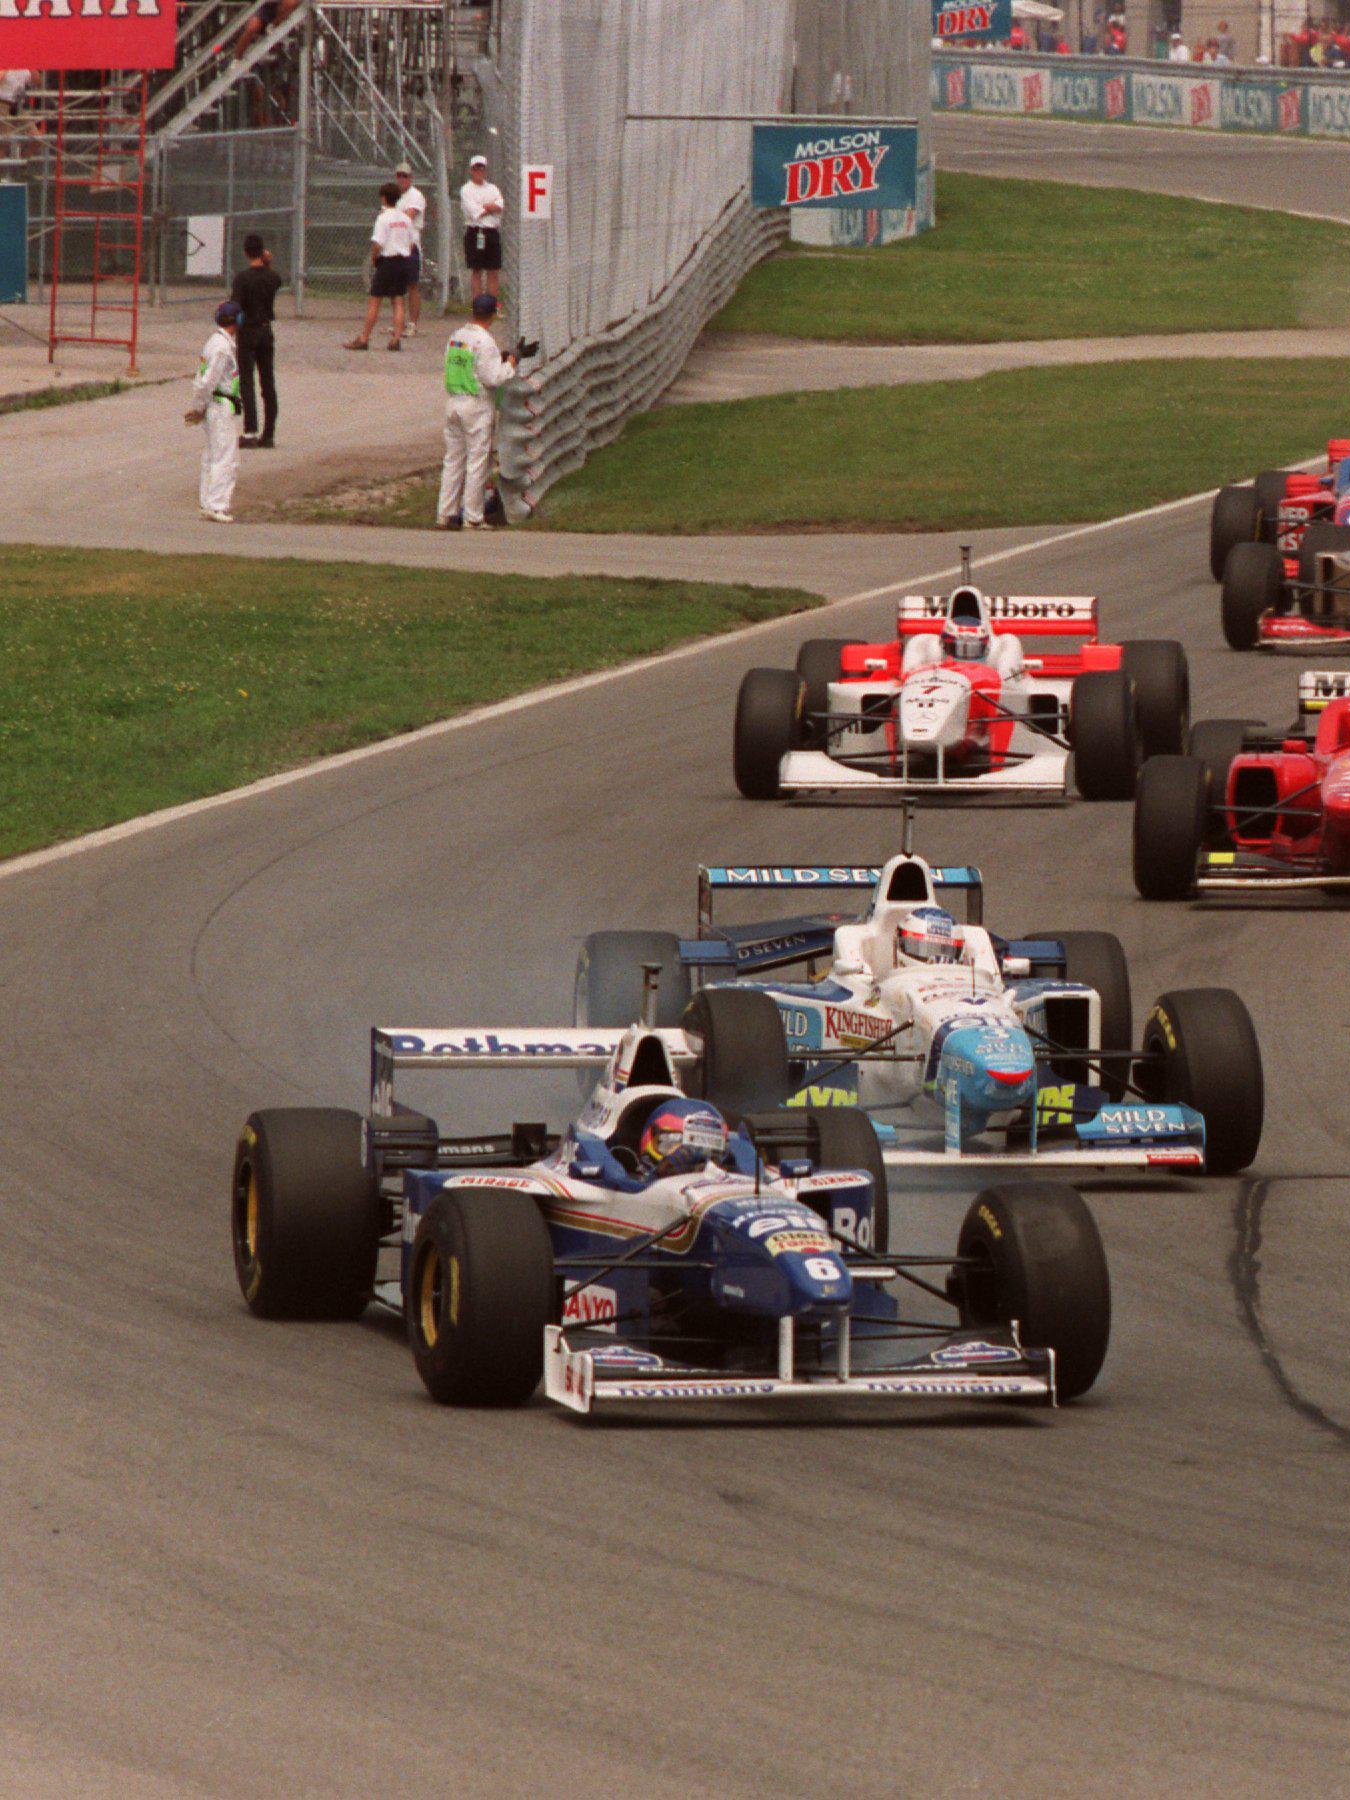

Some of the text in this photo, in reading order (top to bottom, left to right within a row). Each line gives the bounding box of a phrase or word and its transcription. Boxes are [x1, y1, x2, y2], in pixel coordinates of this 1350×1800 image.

[935, 5, 998, 36] DRY
[794, 130, 882, 159] MOLSON
[780, 145, 890, 206] DRY
[527, 171, 546, 212] F
[726, 868, 821, 883] MILD
[752, 934, 808, 956] SEVEN
[1101, 1110, 1167, 1124] MILD
[1105, 1122, 1187, 1134] SEVEN
[804, 1258, 842, 1281] 6
[562, 1291, 615, 1327] ANYO
